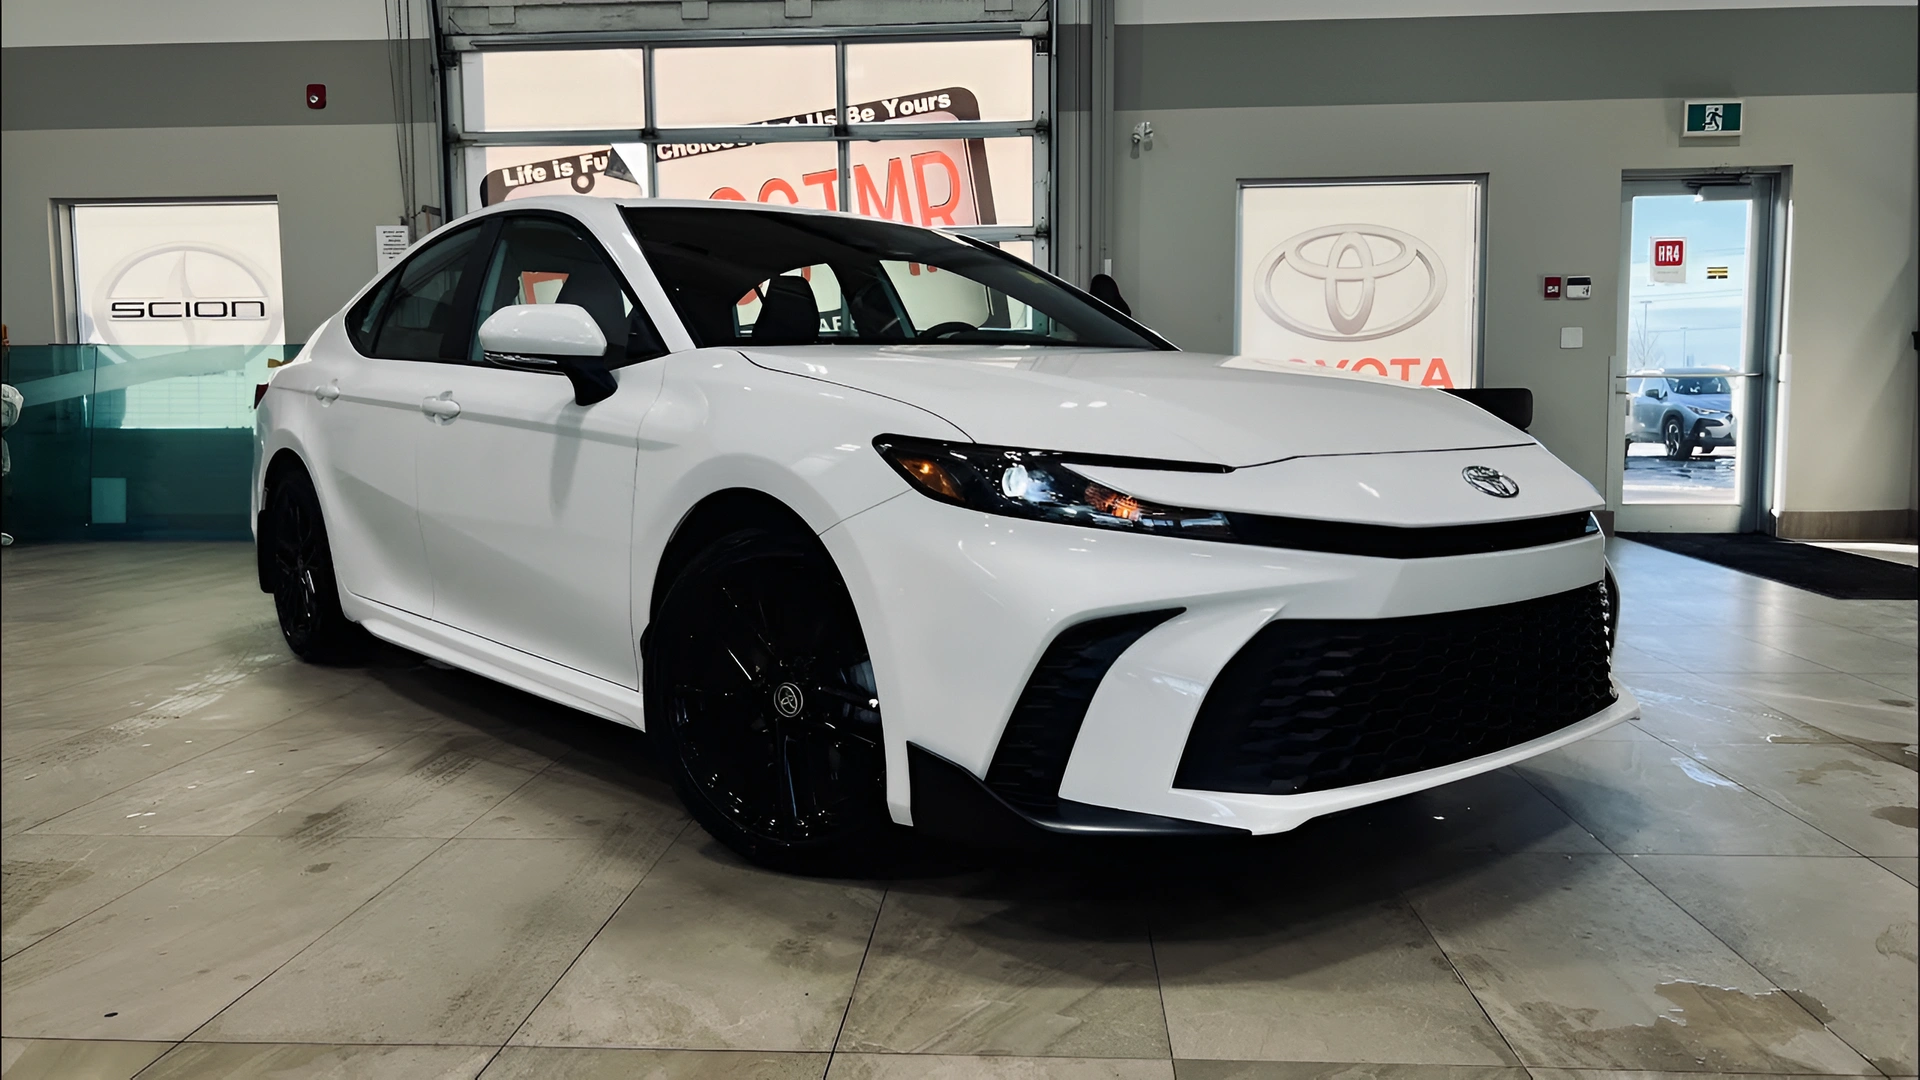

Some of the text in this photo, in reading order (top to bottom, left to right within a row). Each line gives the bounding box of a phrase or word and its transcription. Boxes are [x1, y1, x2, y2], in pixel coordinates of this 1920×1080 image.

[502, 164, 547, 188] Life
[552, 159, 574, 179] is
[579, 150, 611, 174] Fu
[848, 105, 876, 123] Be
[881, 93, 951, 118] Yours
[111, 300, 265, 318] SCION
[1288, 357, 1455, 389] OTA
